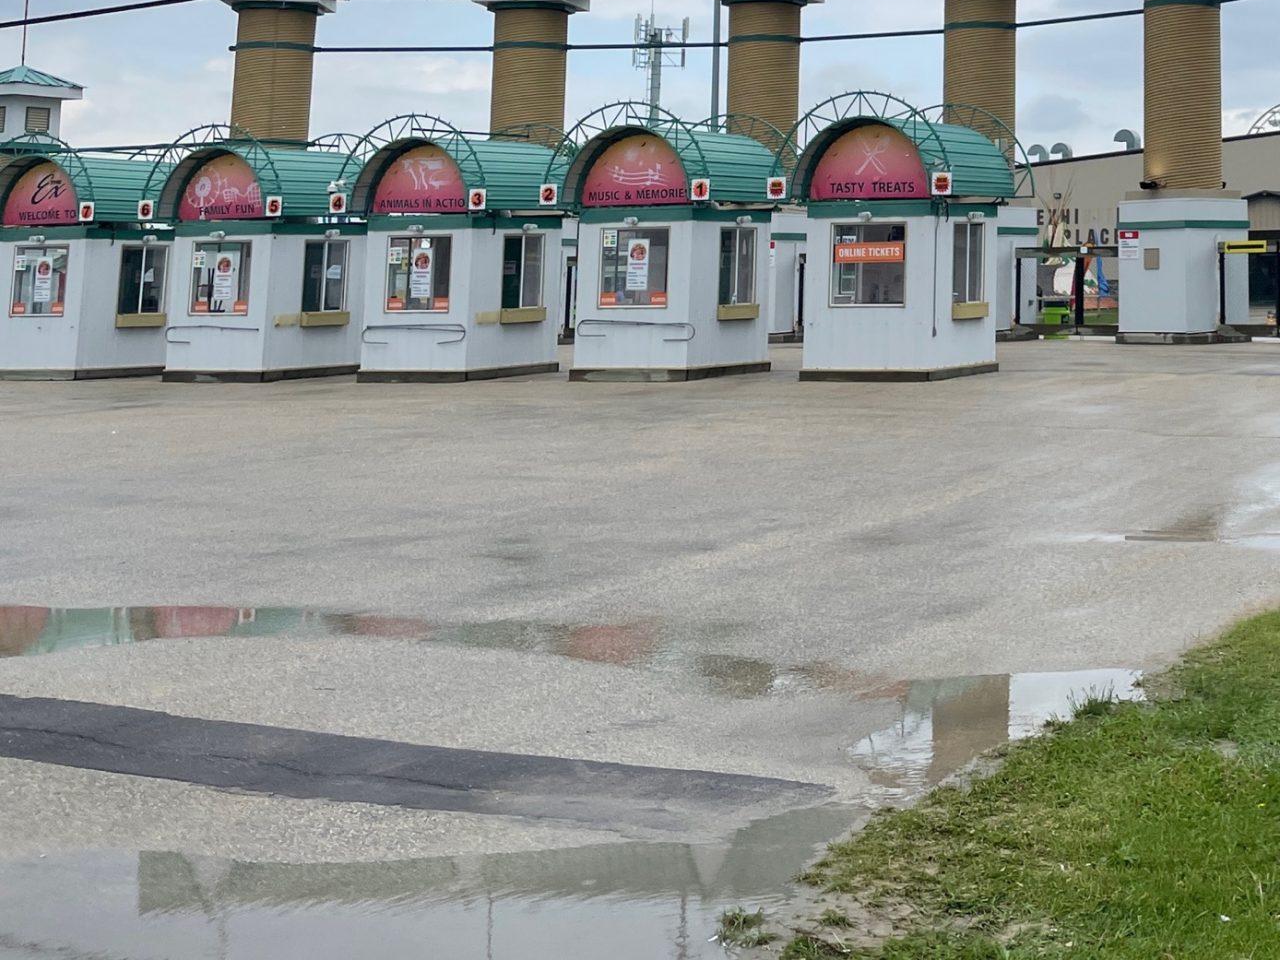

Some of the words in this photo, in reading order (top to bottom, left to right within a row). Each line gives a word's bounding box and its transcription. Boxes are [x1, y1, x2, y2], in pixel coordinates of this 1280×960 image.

[30, 173, 67, 205] Ex
[830, 182, 865, 194] TASTY
[871, 180, 915, 193] TREATS
[472, 192, 482, 207] 3
[544, 187, 554, 201] 2
[588, 190, 620, 201] MUSIC
[624, 190, 632, 200] &
[199, 202, 233, 216] FAMILY
[235, 204, 256, 215] FUN
[270, 200, 279, 213] 5
[380, 199, 420, 209] ANIMALS
[422, 198, 432, 208] IN
[435, 197, 466, 209] ACTIO
[19, 209, 61, 221] WELCOME
[65, 208, 77, 219] TO
[83, 205, 92, 218] 7
[141, 203, 150, 217] 6
[838, 247, 866, 258] ONLINE
[868, 247, 900, 257] TICKETS
